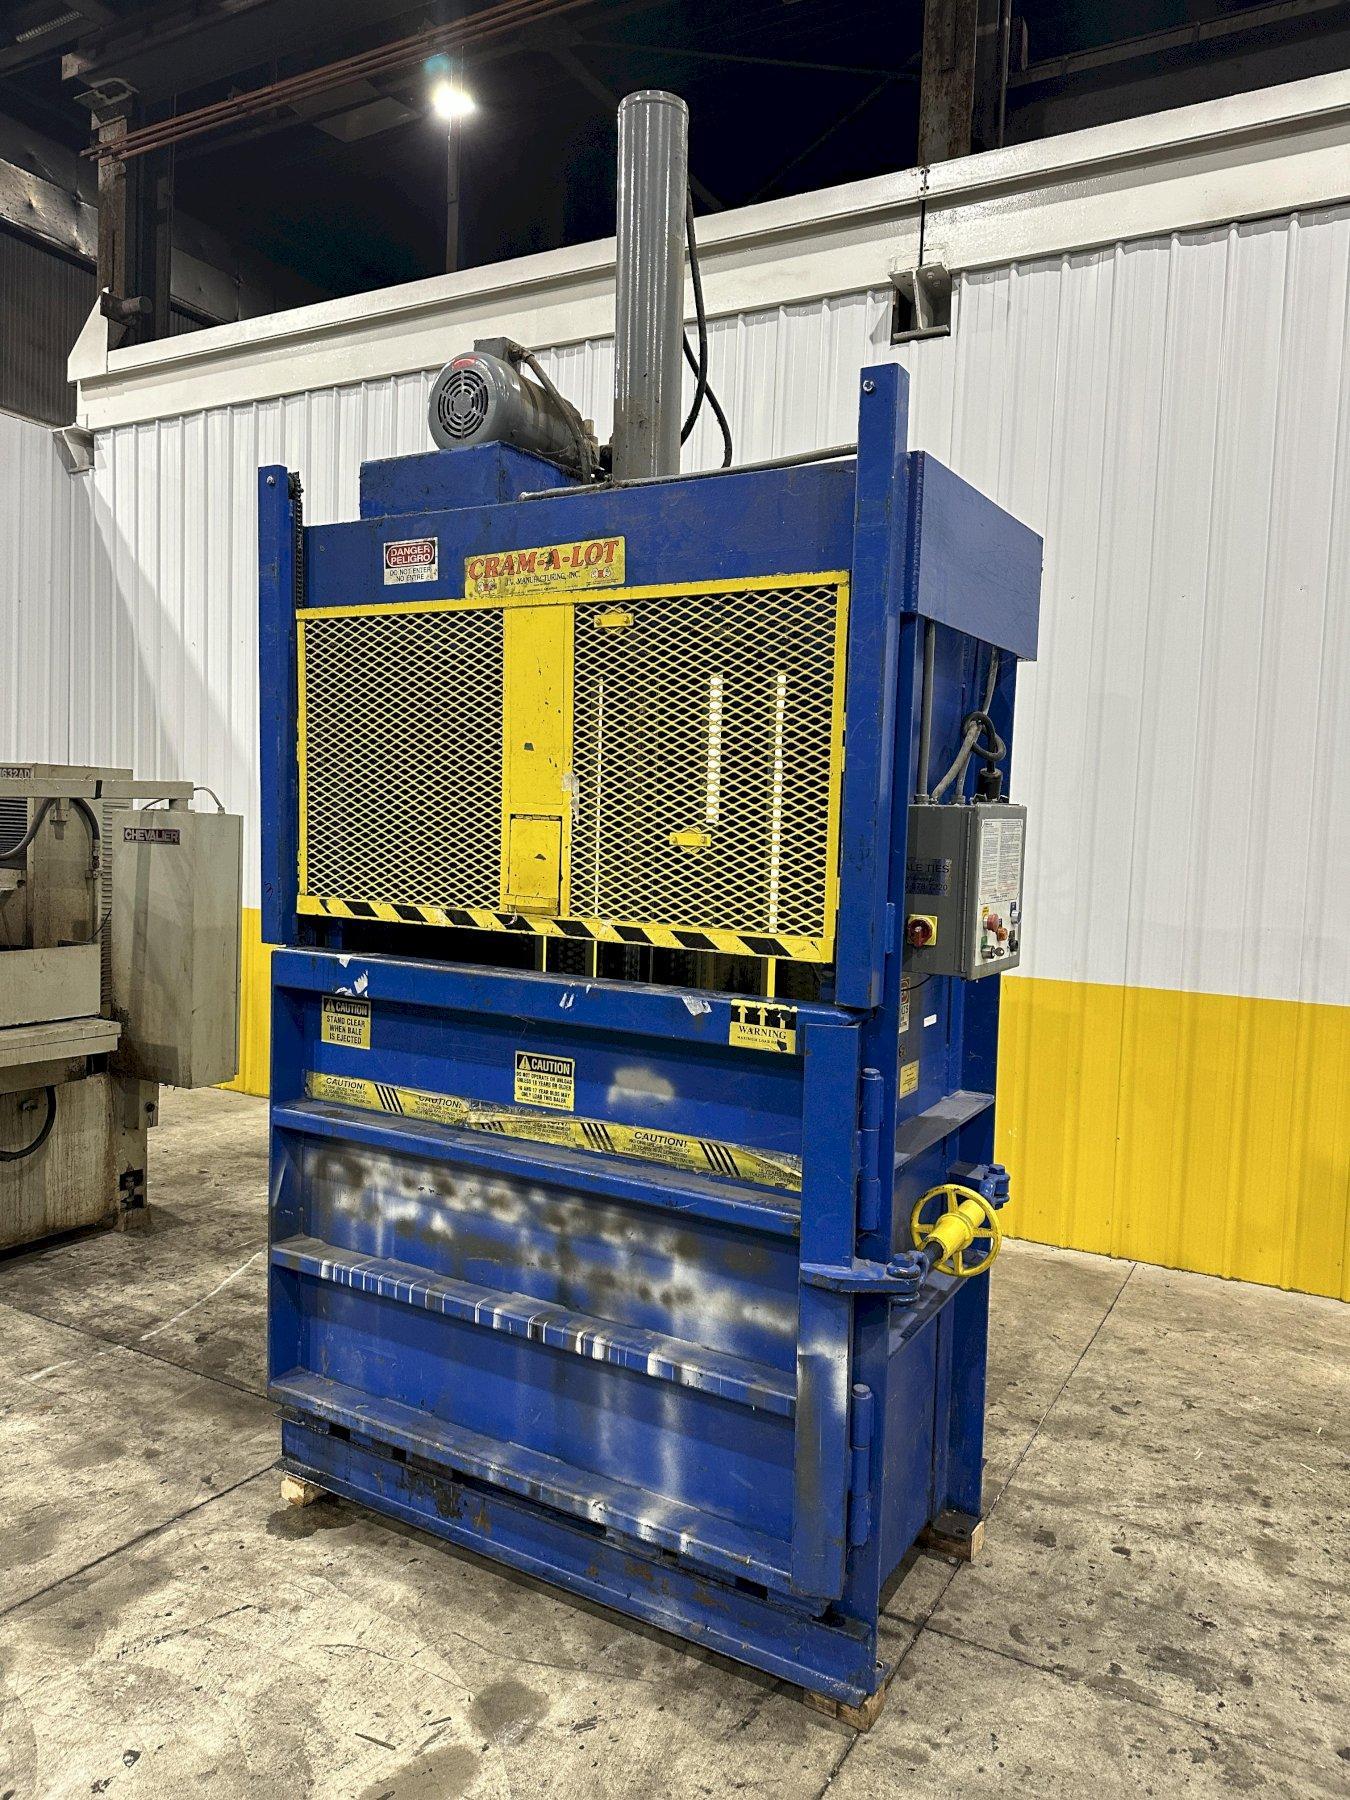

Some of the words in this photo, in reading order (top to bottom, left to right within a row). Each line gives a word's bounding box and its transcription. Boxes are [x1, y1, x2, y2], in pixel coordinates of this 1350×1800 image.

[390, 545, 430, 556] DANGER
[390, 554, 430, 564] PELIGRO
[469, 540, 619, 580] CRAM-A-LOT
[124, 828, 178, 842] CHEVALIER
[336, 1002, 367, 1016] CAUTION
[326, 1015, 346, 1024] STAND
[346, 1018, 366, 1027] CLEAR
[330, 1024, 346, 1033] WHEN
[348, 1026, 362, 1036] BALE
[739, 1025, 786, 1040] WARNING
[336, 1034, 362, 1044] EJECTED
[531, 1058, 570, 1074] CAUTION
[326, 1077, 366, 1090] CAUTION!
[634, 1131, 687, 1148] CAUTION!
